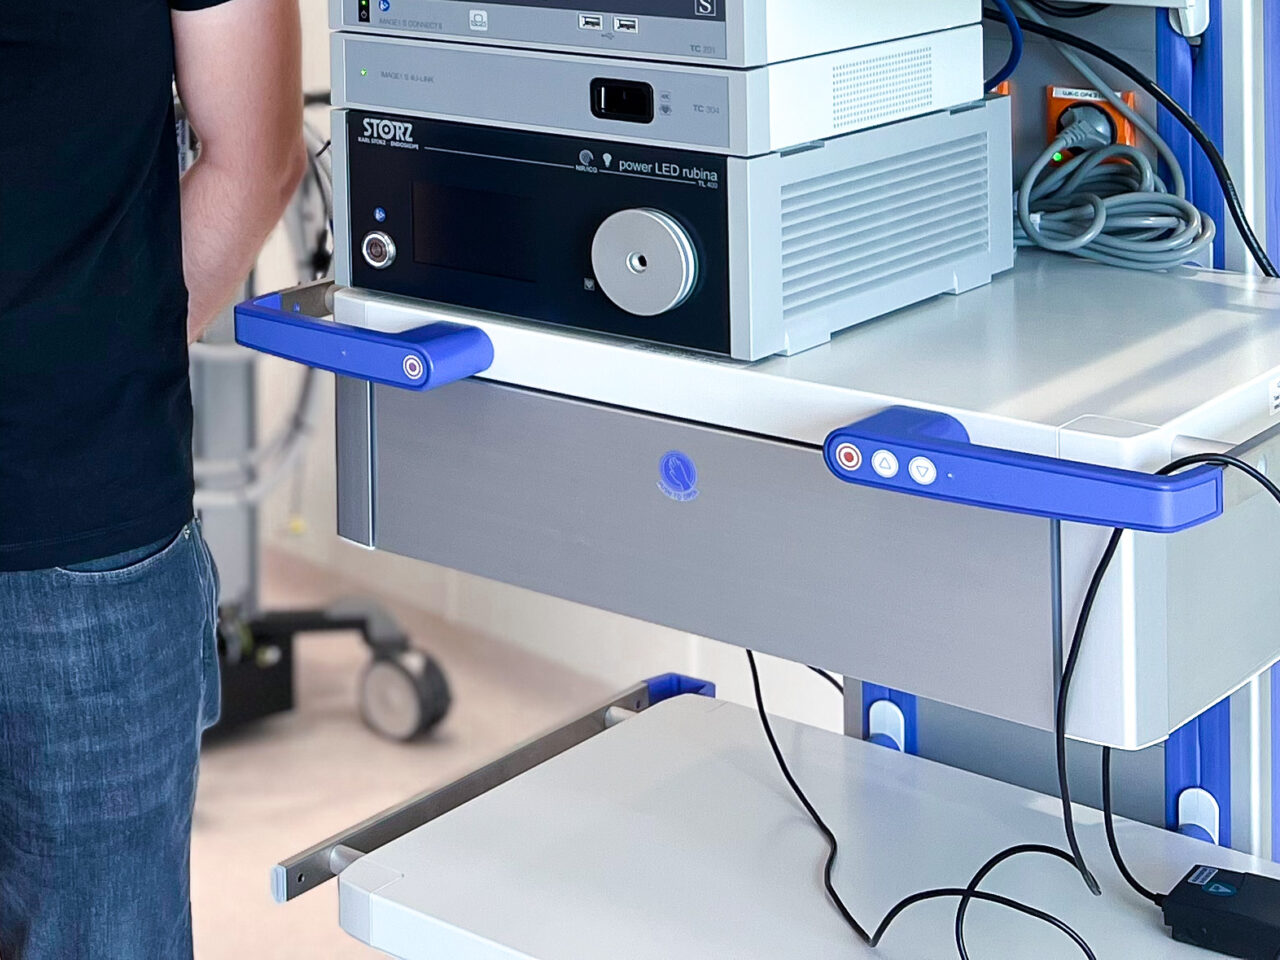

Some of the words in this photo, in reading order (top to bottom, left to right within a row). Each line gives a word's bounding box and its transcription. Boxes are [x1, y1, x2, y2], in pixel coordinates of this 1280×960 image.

[363, 118, 413, 142] STORZ
[619, 160, 653, 172] power
[655, 162, 680, 176] LED
[682, 166, 718, 181] rubina
